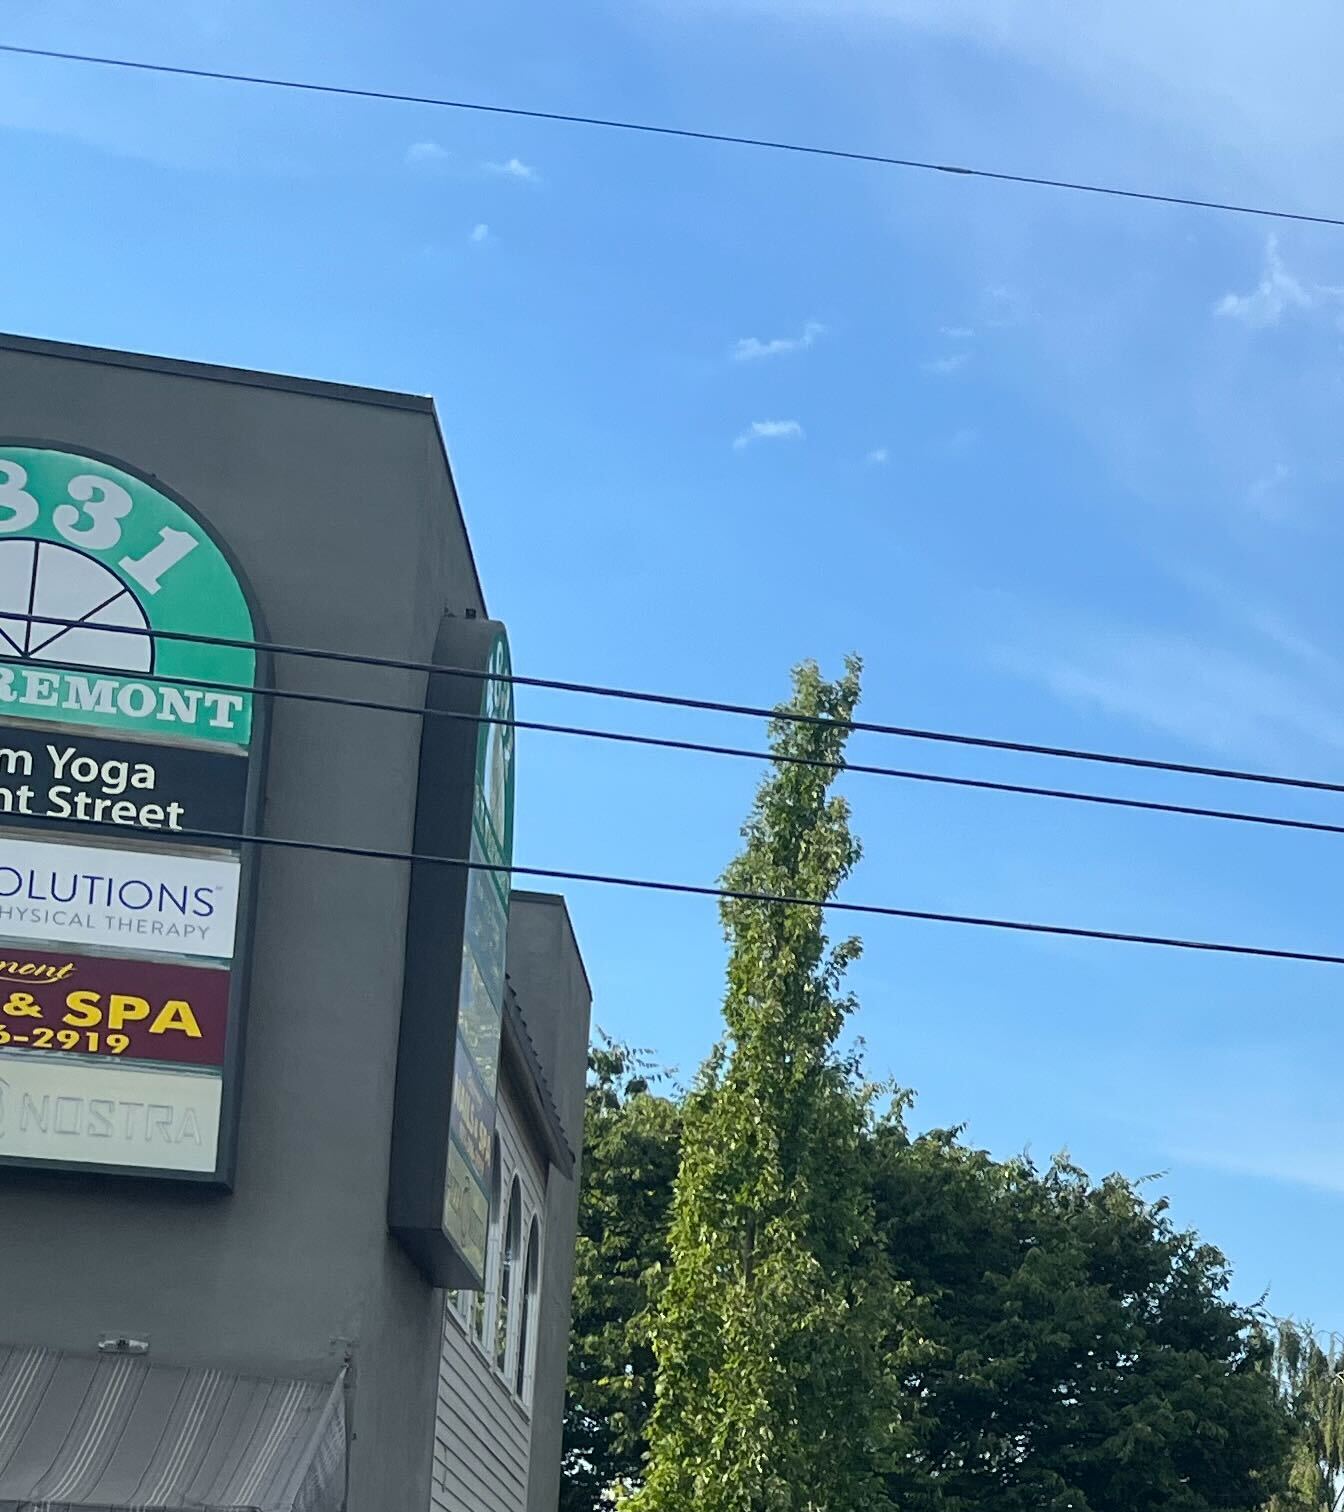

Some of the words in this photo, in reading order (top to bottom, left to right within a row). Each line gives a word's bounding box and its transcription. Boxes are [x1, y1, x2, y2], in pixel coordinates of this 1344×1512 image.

[46, 744, 155, 795] Yoga
[47, 785, 184, 831] Street
[0, 866, 214, 917] OLUTIONS
[105, 915, 211, 940] THERAPY
[3, 992, 43, 1018] &
[62, 990, 202, 1038] SPA
